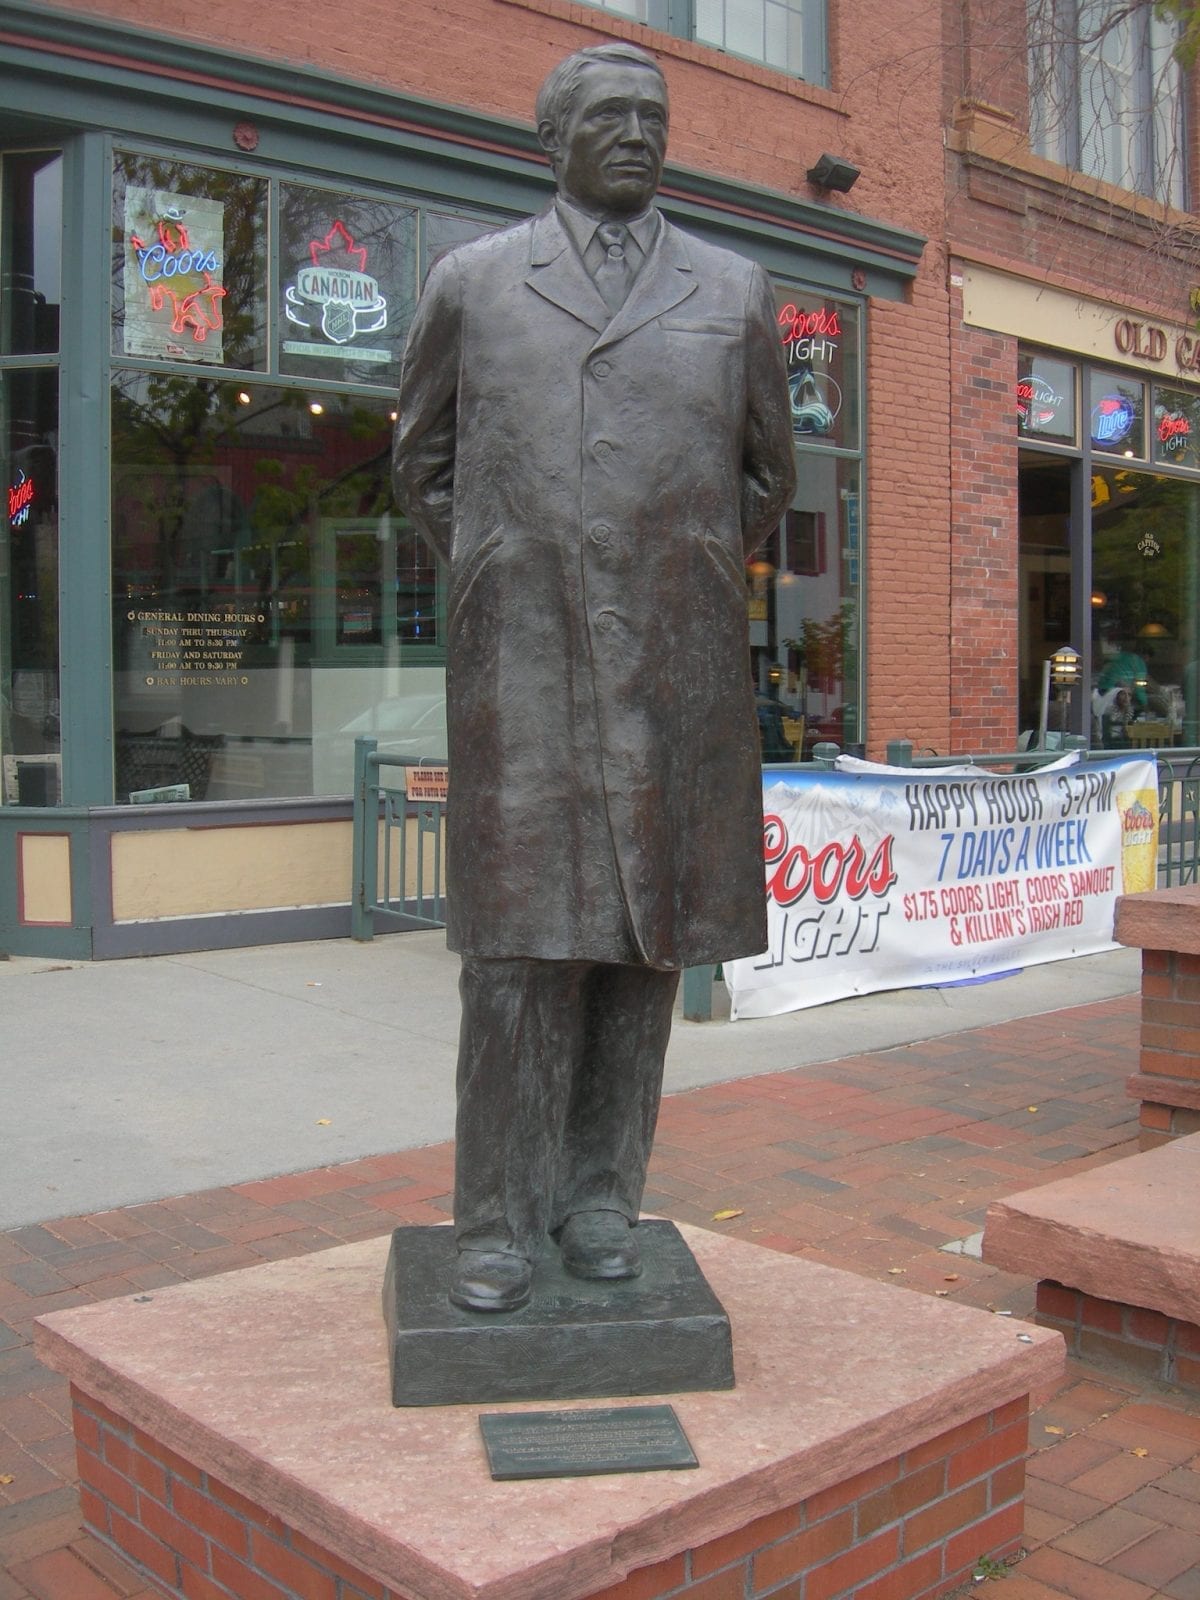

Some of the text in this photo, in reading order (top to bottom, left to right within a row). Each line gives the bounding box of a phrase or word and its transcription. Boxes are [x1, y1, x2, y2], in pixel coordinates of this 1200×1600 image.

[139, 245, 221, 281] Coors
[302, 274, 374, 302] CANADIAN
[778, 303, 842, 344] Coors
[788, 338, 839, 364] IGHT
[1115, 319, 1168, 363] OLD
[1034, 389, 1064, 407] LIGHT
[1097, 410, 1129, 440] Lite
[1160, 436, 1188, 457] LIGHT
[9, 479, 33, 517] oors
[137, 611, 256, 623] GENERAL DINING HOURS
[146, 627, 247, 637] SUNDAY THRU THURSDAY
[179, 639, 191, 647] AM
[226, 640, 237, 648] PM
[151, 651, 242, 660] FRIDAY AND SATURDAY
[180, 661, 191, 670] AM
[226, 662, 237, 670] PM
[180, 677, 211, 687] HOURS
[214, 677, 239, 687] VARY
[905, 771, 1117, 831] HAPPY HOUR 3-7PM
[1123, 807, 1155, 832] Coors
[938, 819, 1092, 881] 7 DAYS A WEEK
[904, 866, 1116, 922] $1.75 COORS LIGHT, COORS BANQUET
[754, 902, 891, 970] IGHT
[949, 899, 1084, 946] & KILLIAN'S IRISH RED
